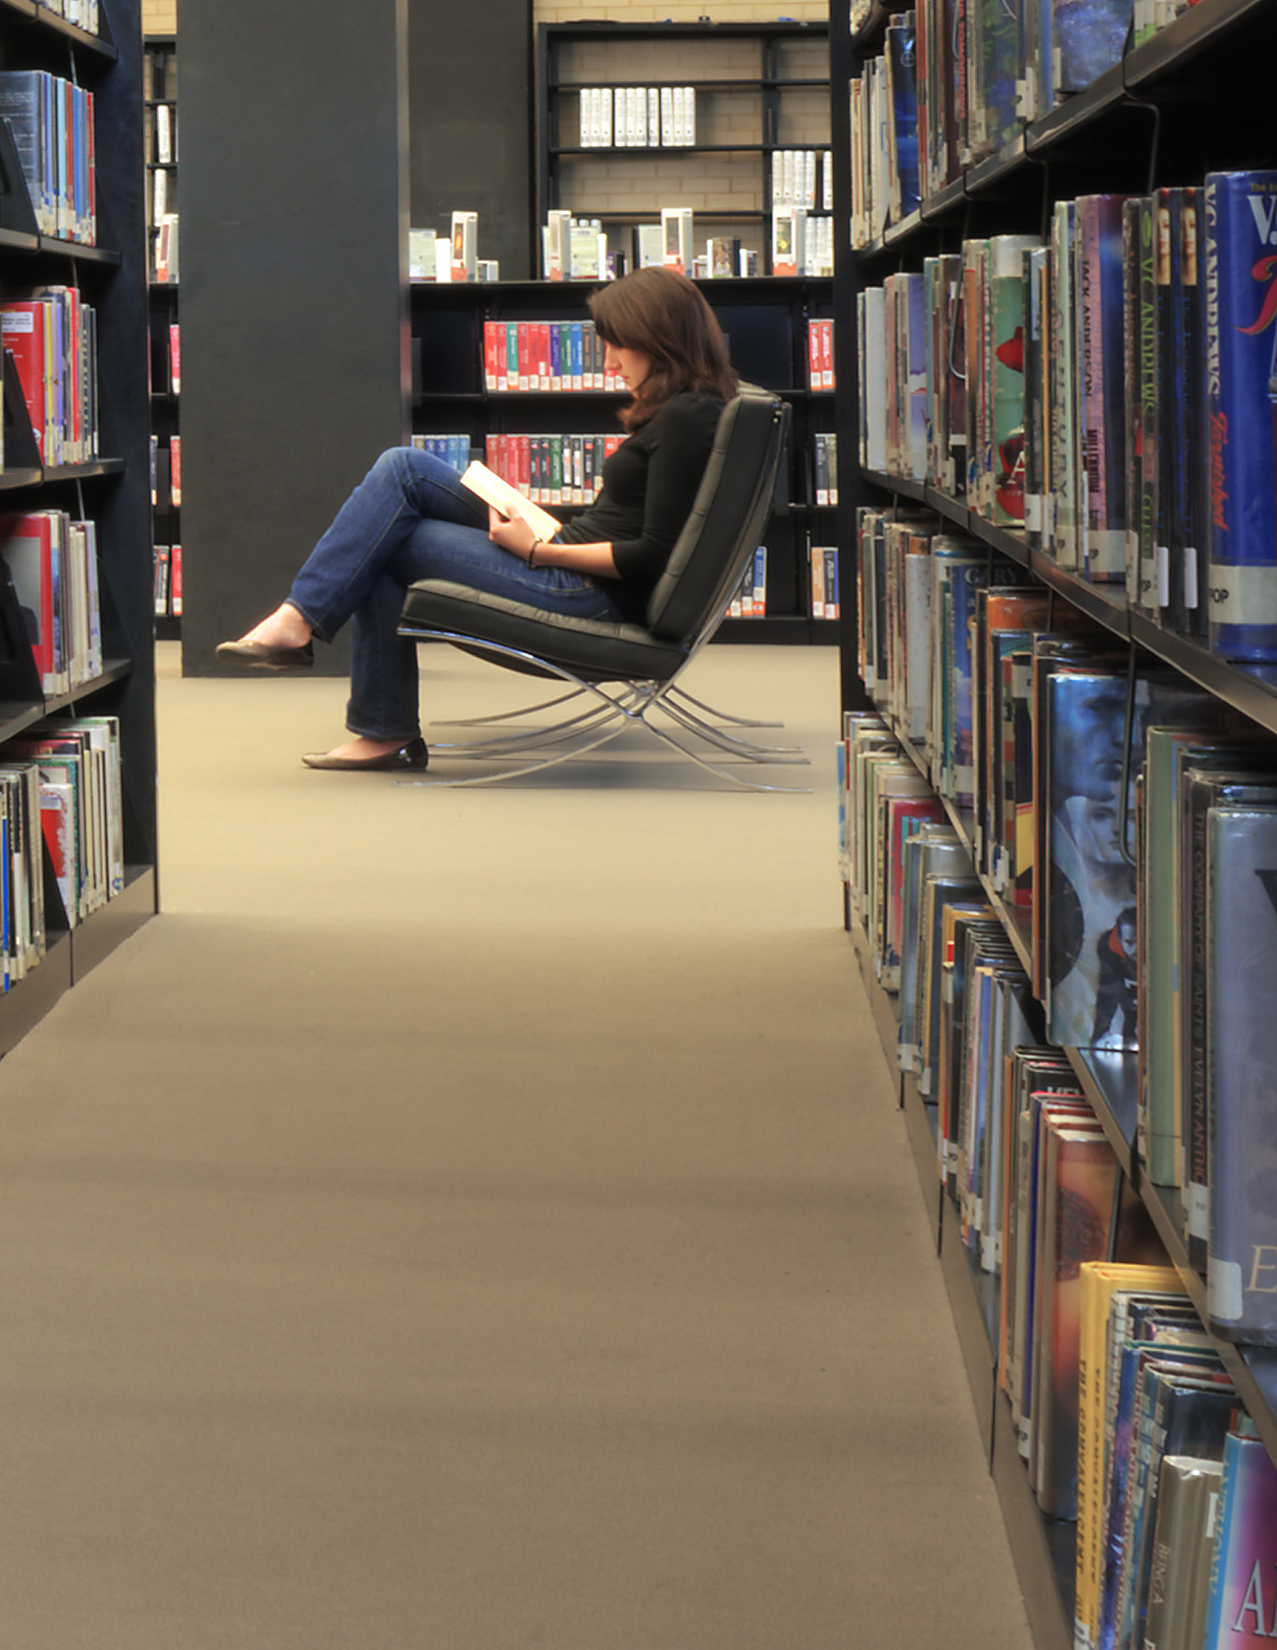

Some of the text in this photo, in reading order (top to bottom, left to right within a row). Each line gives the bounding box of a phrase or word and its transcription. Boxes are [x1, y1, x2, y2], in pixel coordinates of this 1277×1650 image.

[1082, 259, 1094, 397] JACK ANDERSON
[1141, 301, 1155, 416] ANDREWS
[1205, 237, 1222, 395] ANDREWS
[1055, 308, 1067, 499] CENTURY
[1193, 850, 1206, 942] COMPANY
[1194, 970, 1206, 1039] SAINTS
[1193, 1044, 1206, 1116] EVELYN
[1193, 1115, 1206, 1184] ANTHO
[1076, 1358, 1088, 1577] THE CONVALESCENT
[1154, 1541, 1170, 1588] BEING
